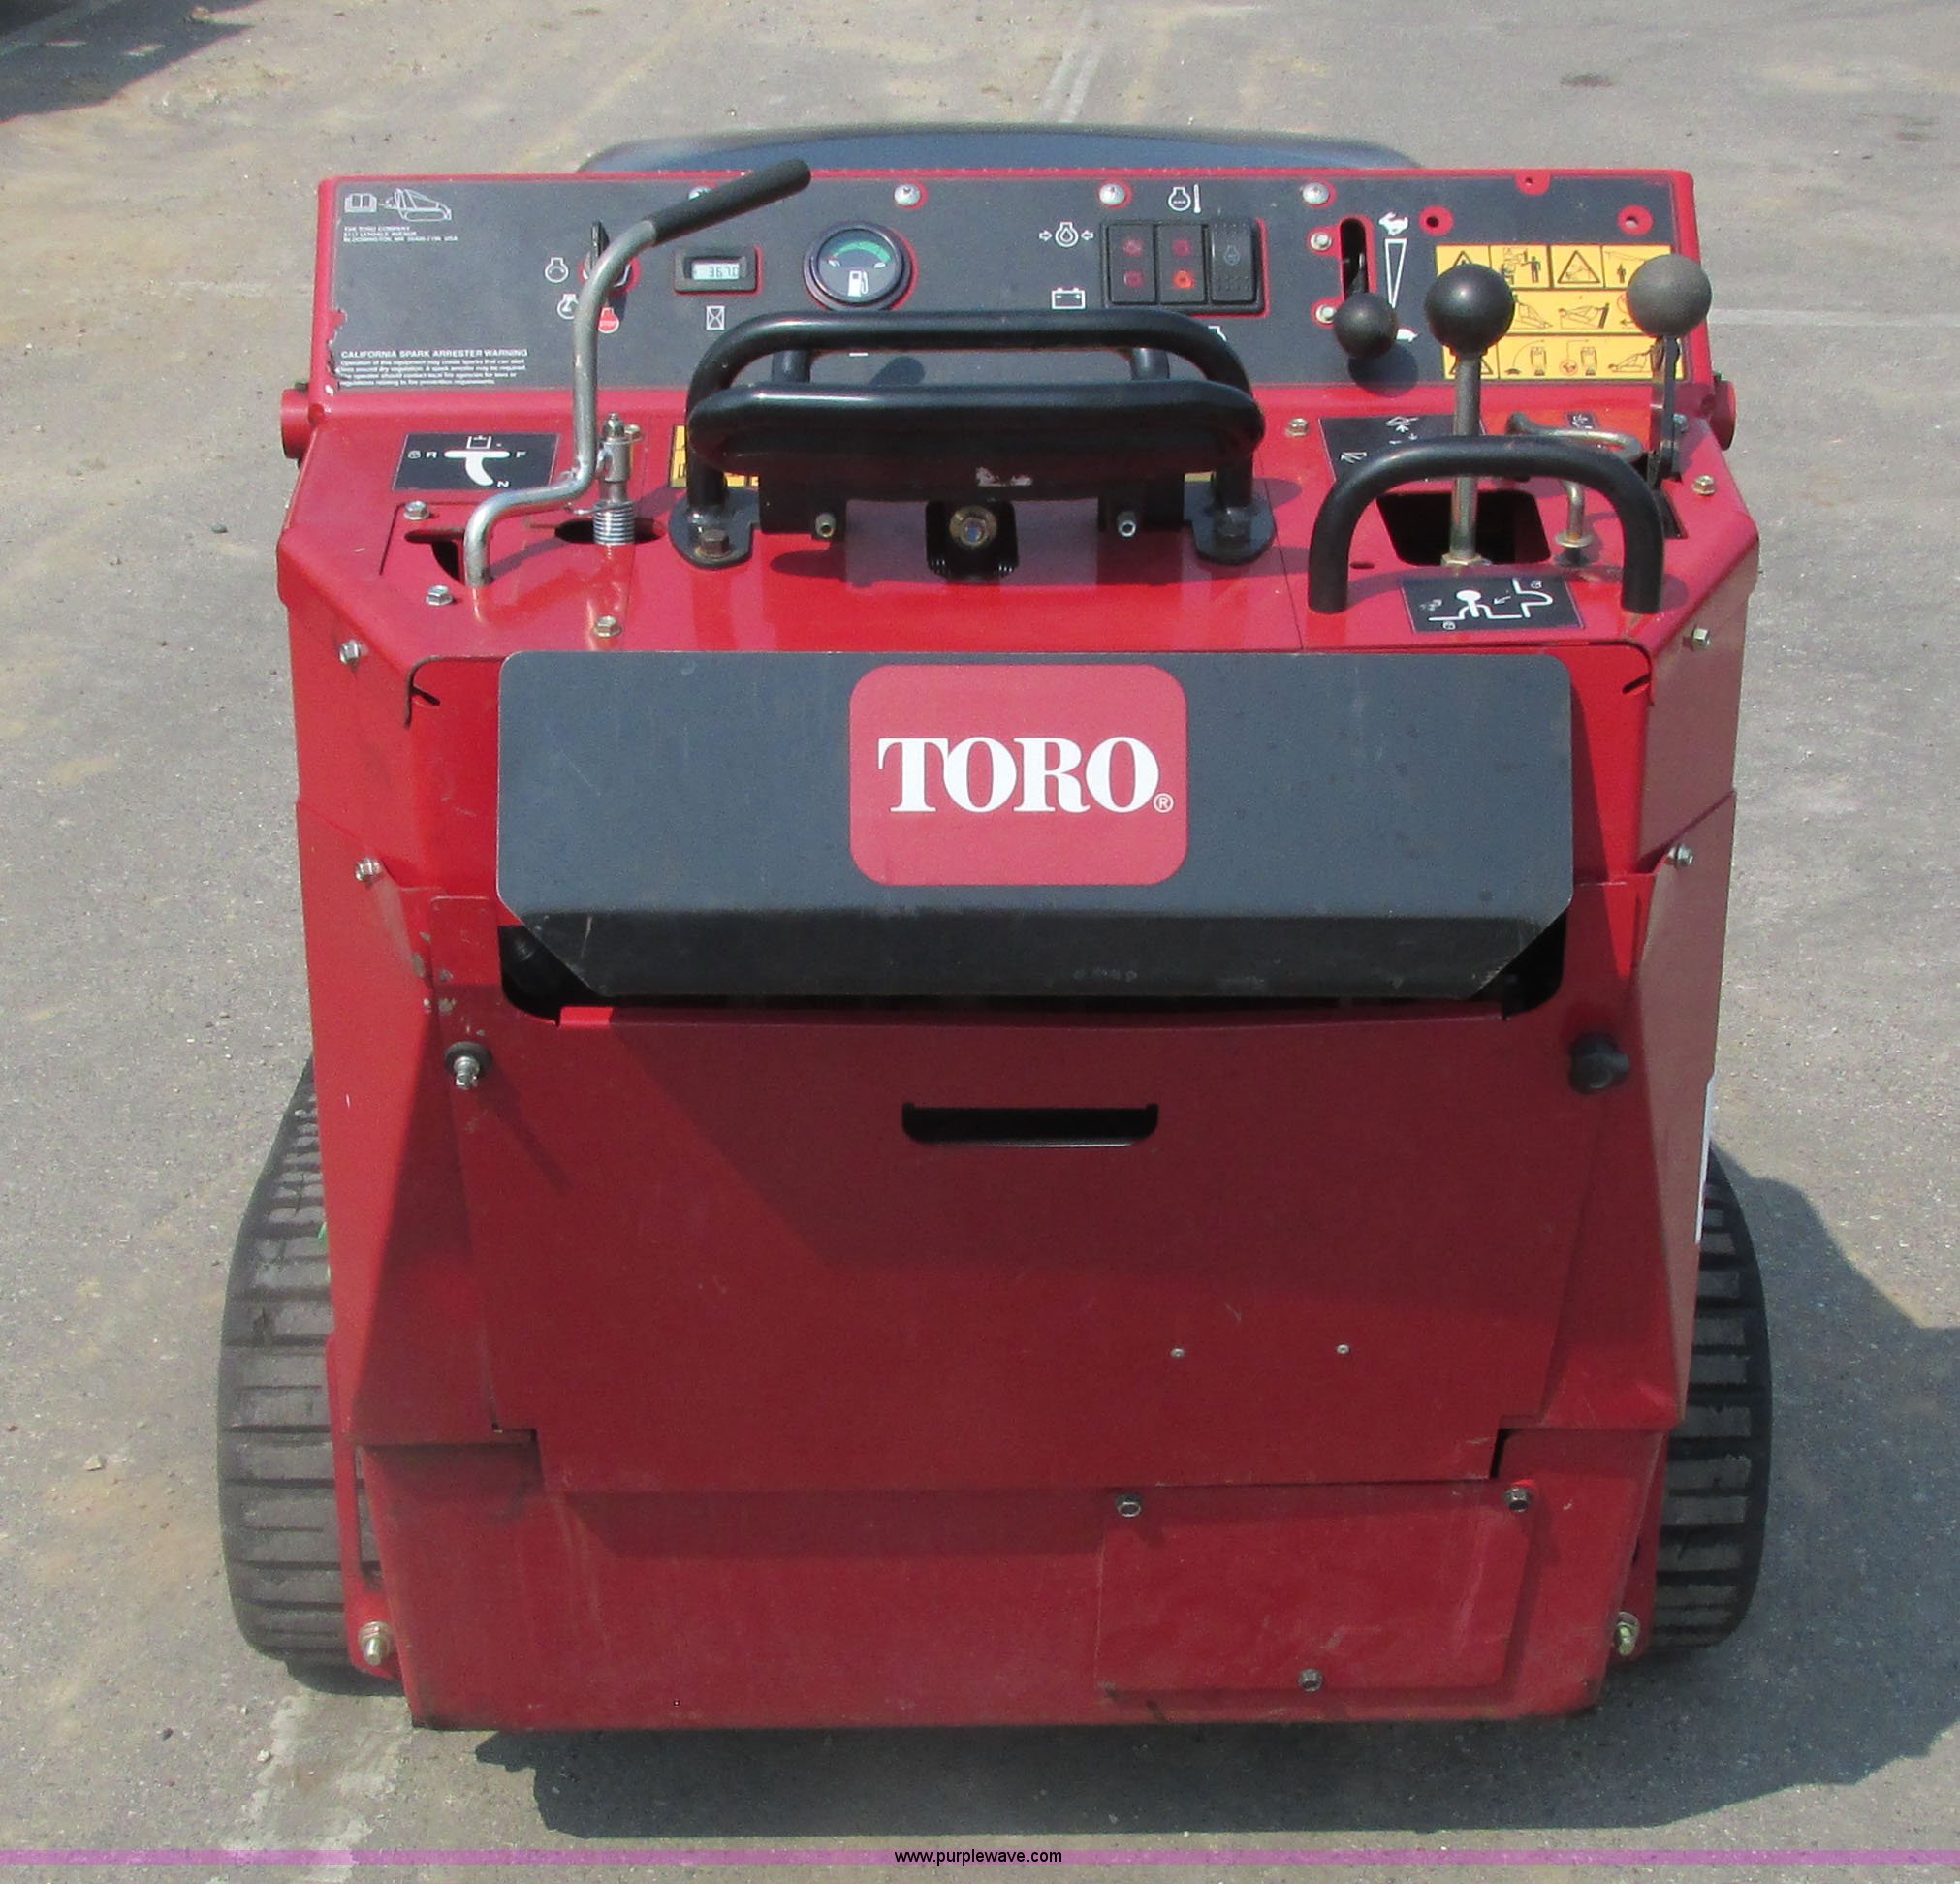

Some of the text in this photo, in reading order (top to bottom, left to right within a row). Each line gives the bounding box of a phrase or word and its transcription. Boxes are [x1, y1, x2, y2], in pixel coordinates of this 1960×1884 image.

[341, 350, 397, 359] CALIFORNIA
[484, 349, 528, 358] WARNING
[496, 480, 510, 488] N
[878, 737, 1159, 813] TORO
